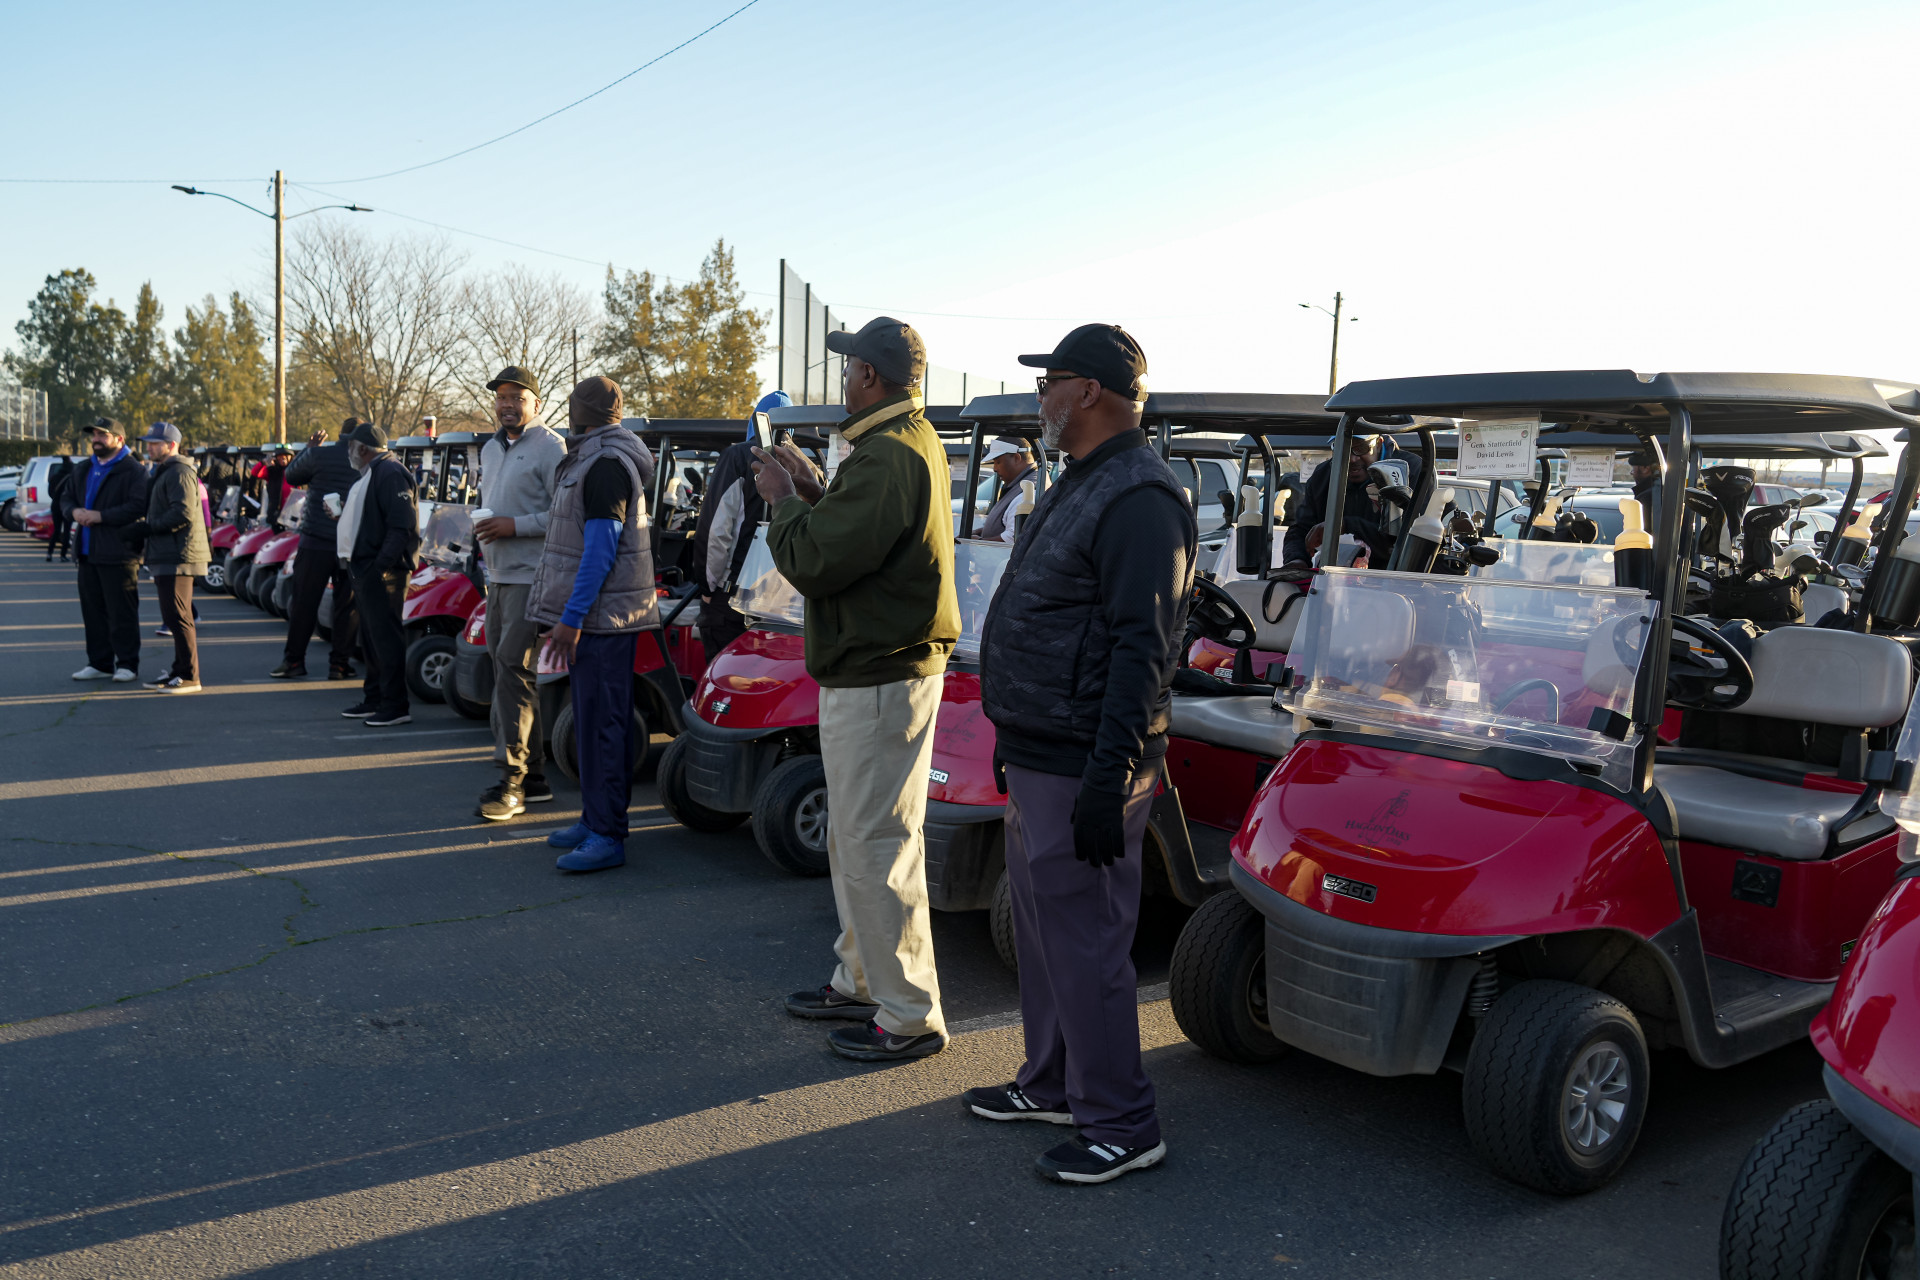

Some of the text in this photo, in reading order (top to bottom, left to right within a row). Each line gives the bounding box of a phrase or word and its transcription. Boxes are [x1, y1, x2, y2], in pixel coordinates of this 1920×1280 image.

[1476, 450, 1514, 459] David Lewis
[1344, 819, 1385, 832] HAGGIN
[1323, 876, 1375, 900] EZGO
